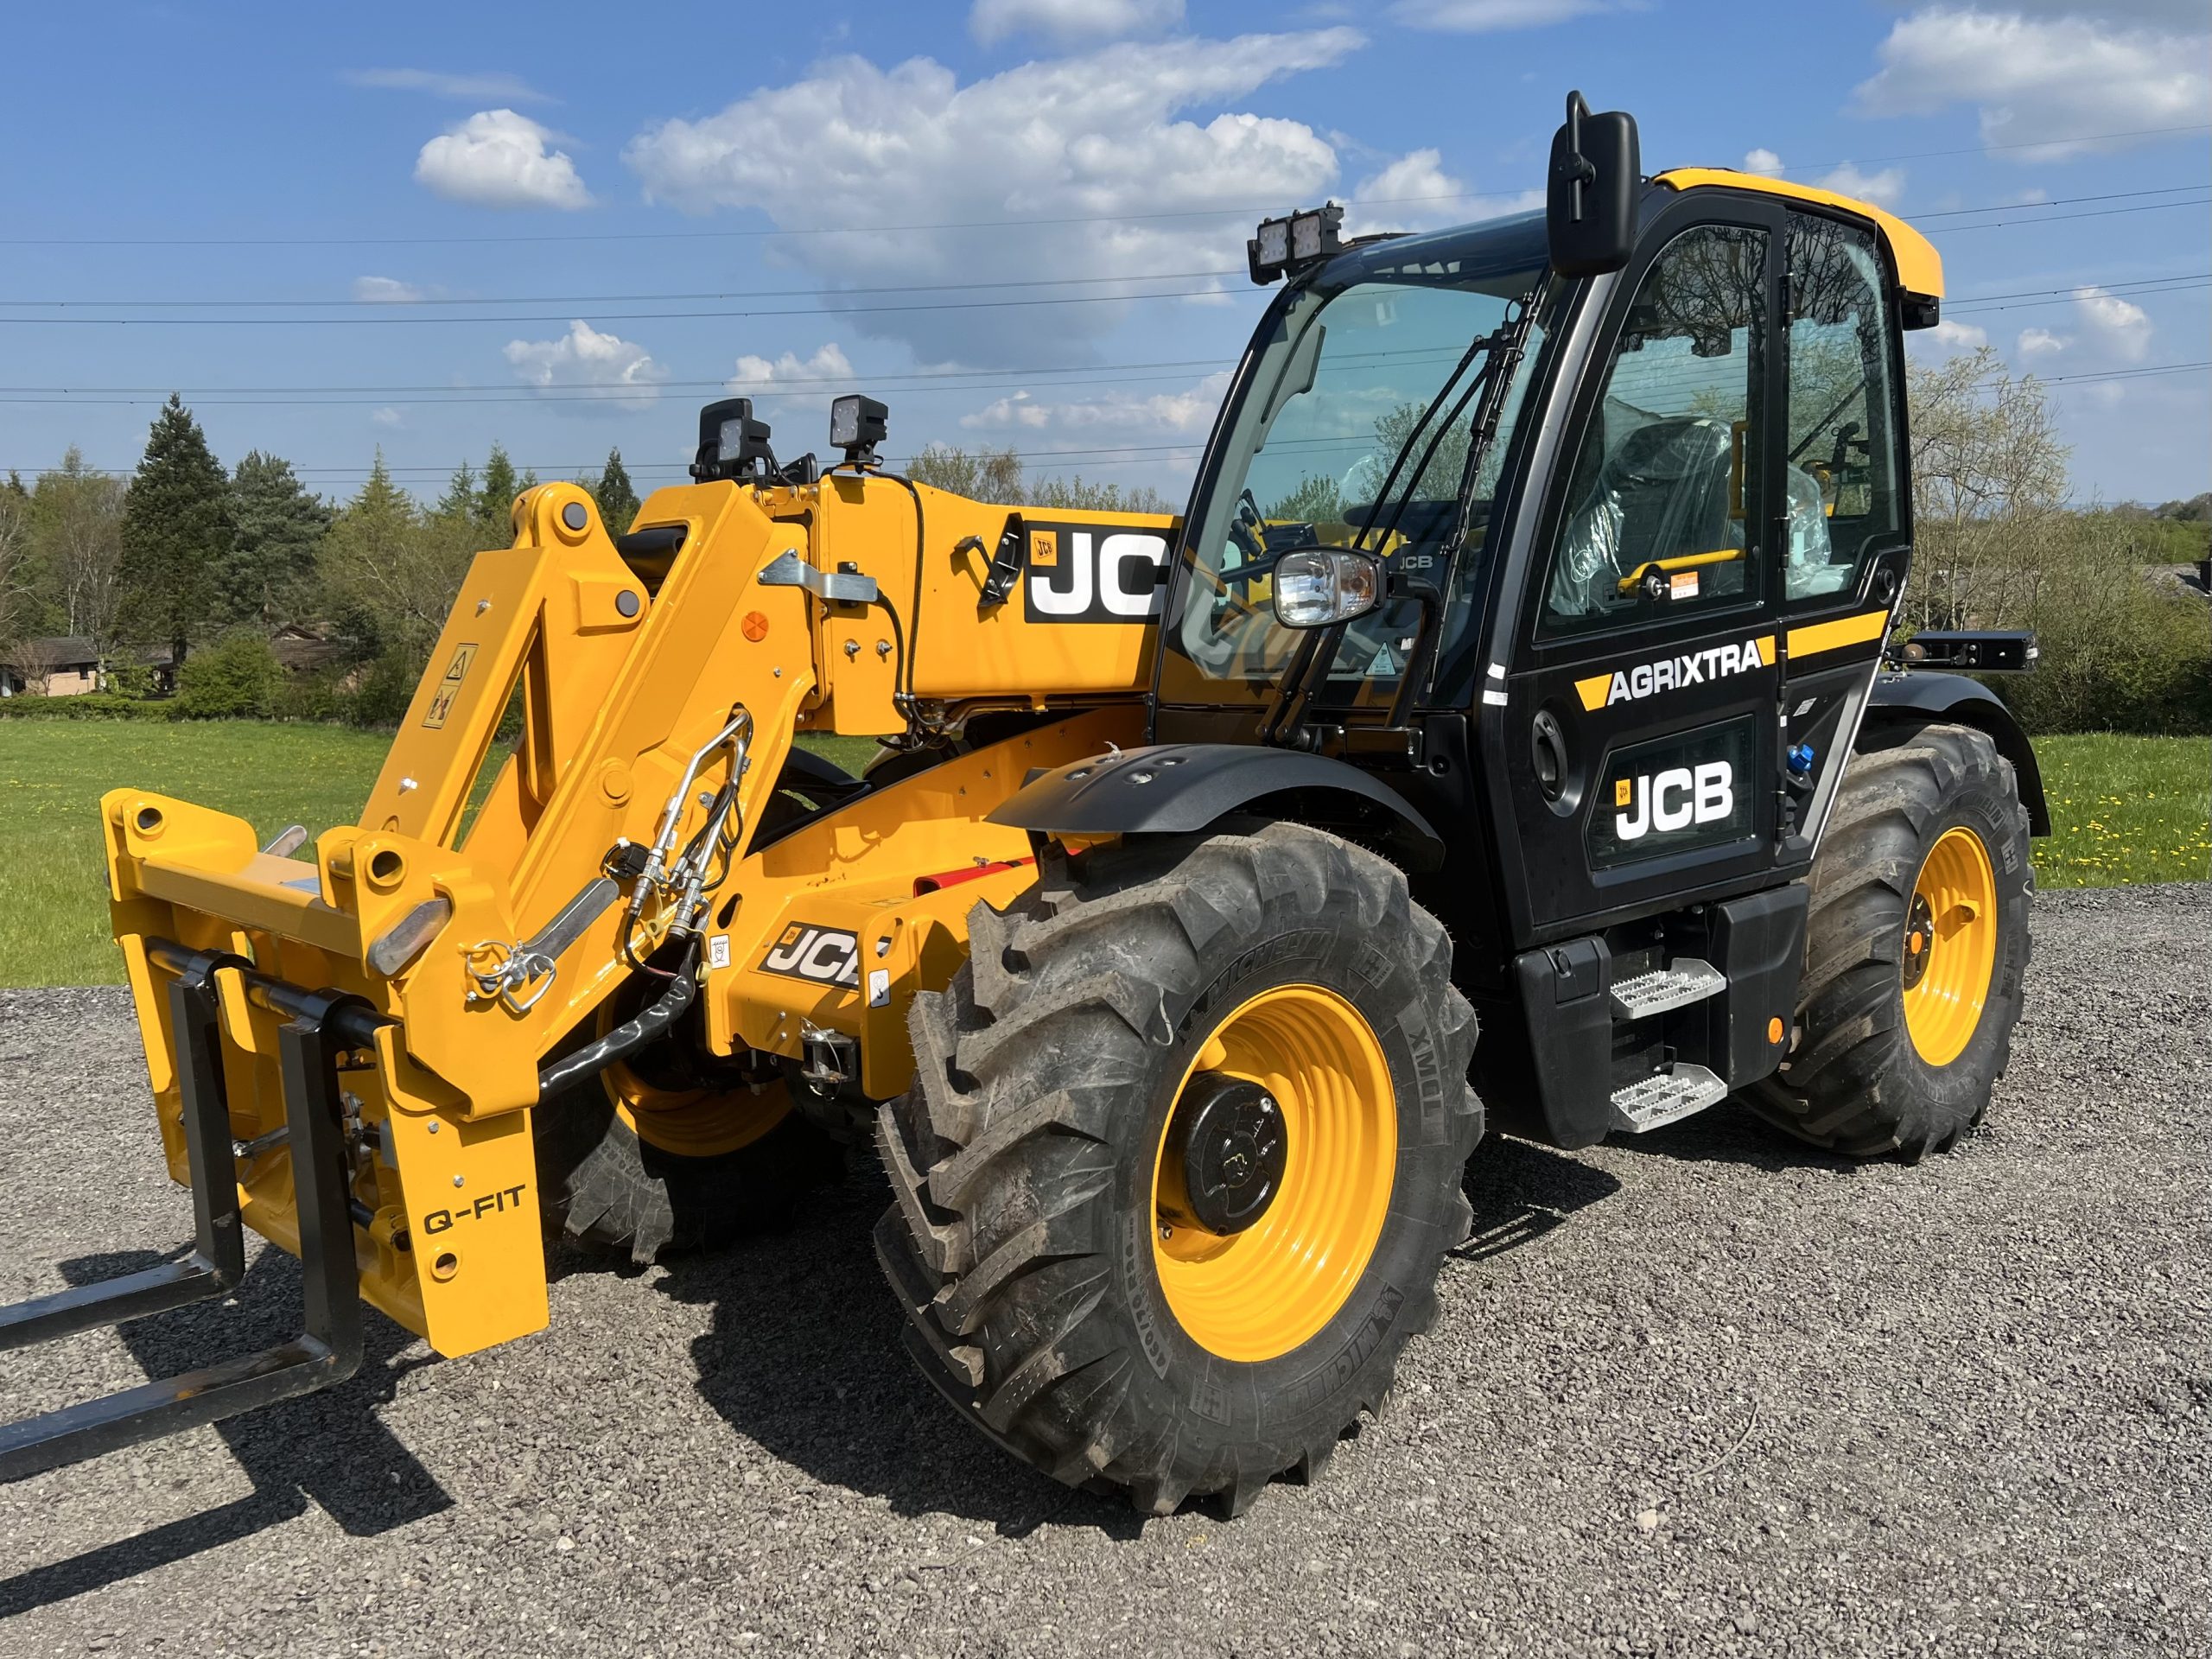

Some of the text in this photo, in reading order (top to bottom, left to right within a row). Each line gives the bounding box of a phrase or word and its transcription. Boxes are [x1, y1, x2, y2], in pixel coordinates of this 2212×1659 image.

[1031, 532, 1172, 615] JC
[1037, 539, 1052, 556] JCB
[1399, 555, 1433, 570] JCB
[1607, 639, 1763, 706] AGRIXTRA
[1616, 760, 1733, 841] JCB
[1408, 1026, 1441, 1118] XMCL
[423, 1184, 526, 1235] Q-FIT
[1132, 1294, 1166, 1368] 460/70
